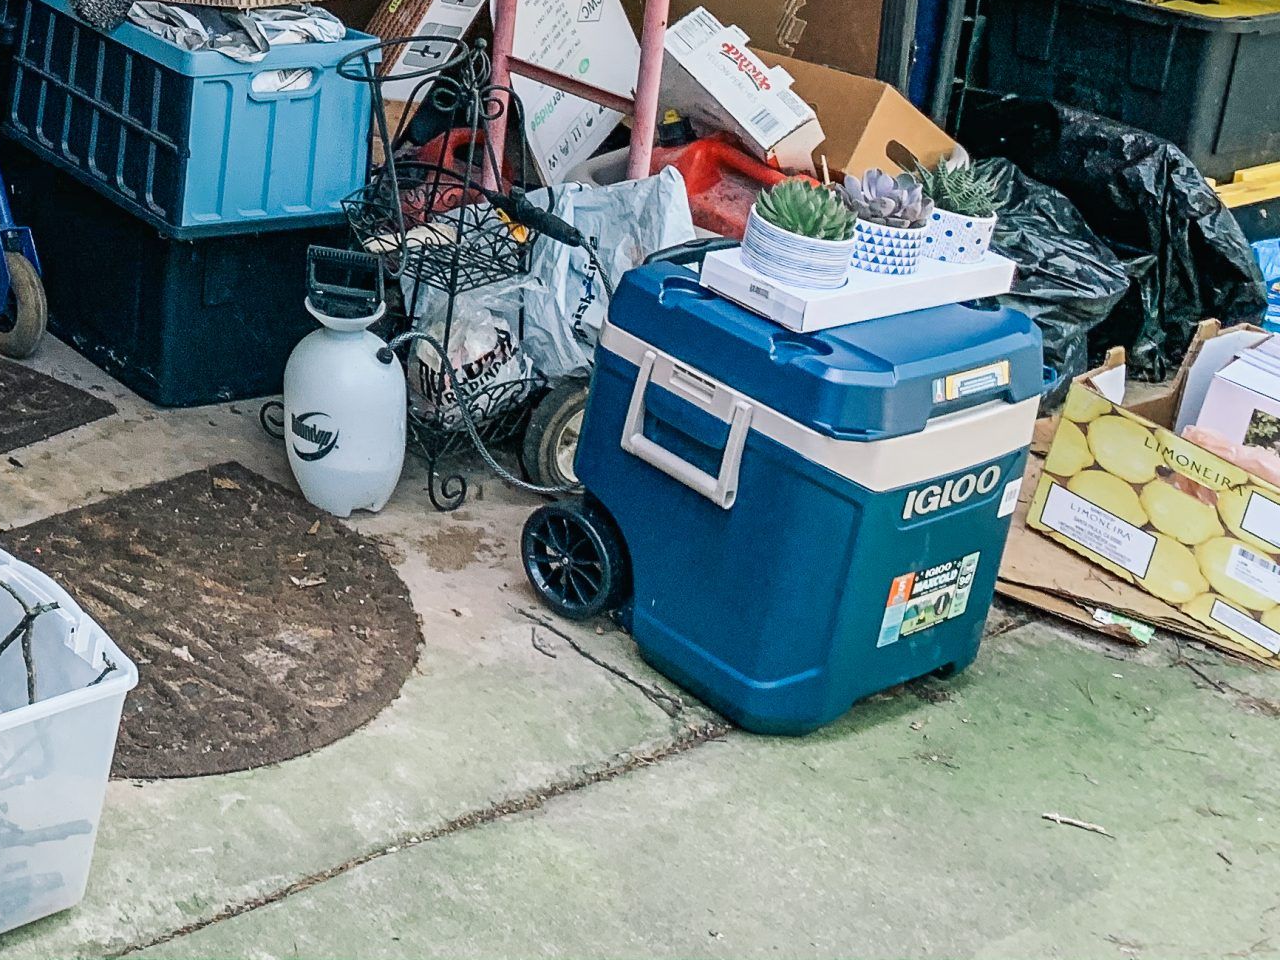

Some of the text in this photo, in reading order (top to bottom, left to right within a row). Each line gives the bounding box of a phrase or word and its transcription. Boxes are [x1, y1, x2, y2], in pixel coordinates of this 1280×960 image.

[1144, 436, 1246, 497] LIMONEIRA
[902, 465, 1001, 520] IGLOO
[1070, 502, 1132, 542] LIMONEIRA
[913, 568, 958, 594] MAXCOLD
[925, 562, 953, 579] IGLOO
